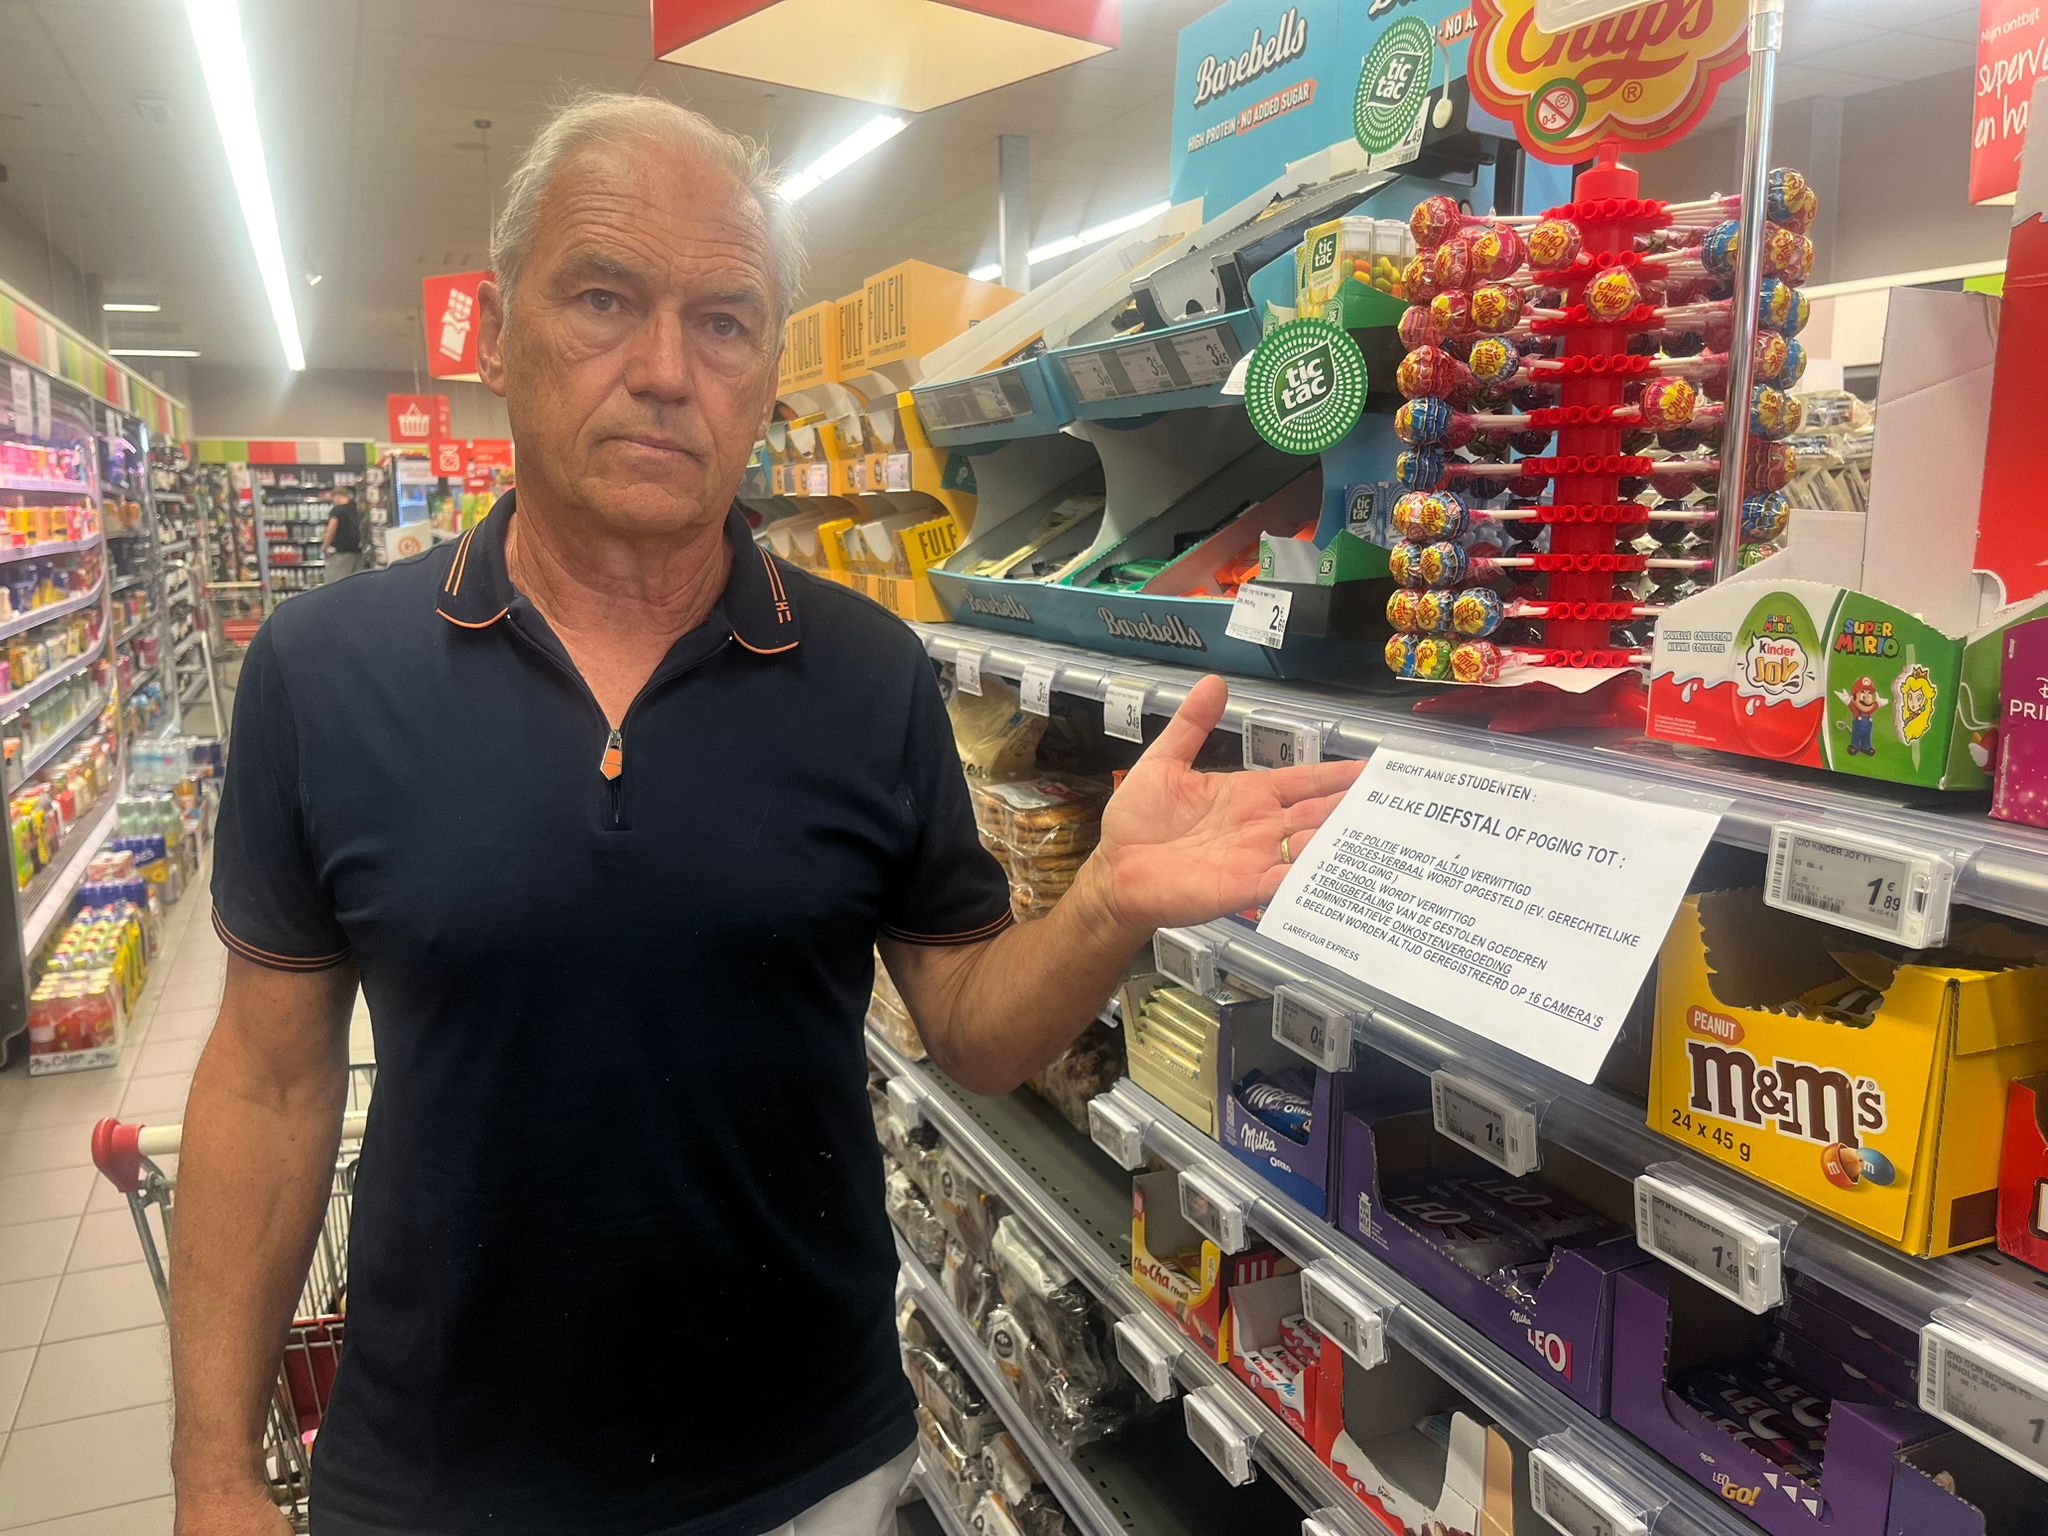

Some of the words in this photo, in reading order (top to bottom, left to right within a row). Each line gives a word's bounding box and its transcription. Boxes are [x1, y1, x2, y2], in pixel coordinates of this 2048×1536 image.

[1445, 15, 1464, 39] NO
[1981, 25, 2000, 44] Mijn
[2003, 7, 2040, 36] ontbijt
[1193, 7, 1307, 110] Barebells
[1387, 57, 1412, 82] tic
[1375, 78, 1405, 100] tac
[1188, 131, 1205, 152] HIGH
[1206, 117, 1236, 145] PROTEIN
[1241, 110, 1252, 128] NO
[1254, 97, 1280, 122] ADDED
[1281, 83, 1310, 110] SUGAR
[1542, 114, 1557, 125] 0-5
[1975, 116, 1996, 149] en
[1319, 239, 1334, 254] tic
[1315, 253, 1332, 267] tac
[1593, 291, 1628, 309] Chups
[1599, 281, 1632, 294] Chupa
[868, 274, 906, 346] FULFIL
[1206, 344, 1220, 366] 3
[1285, 358, 1323, 388] tic
[1281, 376, 1327, 409] tac
[1667, 383, 1686, 415] Chupa
[1353, 508, 1369, 520] tac
[1357, 496, 1370, 511] tic
[918, 523, 956, 560] FULF
[968, 591, 1034, 622] Barebells
[1269, 605, 1280, 631] 2
[1767, 614, 1791, 624] SUPER
[1097, 605, 1207, 651] Barebells
[1663, 631, 1691, 640] NOUVELLE
[1694, 631, 1732, 641] COLLECTION
[1763, 622, 1794, 634] MARIO
[1844, 618, 1894, 638] SUPER
[1668, 642, 1690, 651] NIEUWE
[1692, 643, 1725, 653] COLLECTIE
[1759, 641, 1795, 657] kinder
[1834, 632, 1900, 658] MARIO
[1753, 657, 1799, 685] JOY
[1126, 704, 1132, 726] 3
[1280, 743, 1288, 761] 0
[1385, 760, 1424, 777] BERICHT
[1424, 768, 1444, 781] AAN
[1444, 772, 1457, 784] DE
[1458, 773, 1532, 801] STUDENTEN
[1367, 790, 1388, 805] BIJ
[1388, 796, 1425, 815] ELKE
[1424, 802, 1501, 837] DIEFSTAL
[1505, 825, 1526, 842] OF
[1526, 831, 1584, 858] POGING
[1586, 845, 1619, 866] TOT
[1812, 842, 1842, 856] KINDER
[1844, 849, 1862, 860] JOY
[1333, 852, 1394, 880] VERVOLGING
[1361, 834, 1400, 854] POLITIE
[1400, 845, 1437, 866] WORDT
[1434, 858, 1469, 879] ALTIJD
[1472, 868, 1532, 897] VERWITTIGD
[1337, 868, 1376, 892] SCHOOL
[1379, 884, 1417, 904] WORDT
[1416, 898, 1476, 927] VERWITTIGD
[1867, 877, 1883, 905] 1
[1887, 882, 1896, 891] €
[1426, 870, 1464, 890] WORDT
[1463, 883, 1524, 911] OPGESTELD
[1524, 903, 1545, 918] (EV.
[1547, 910, 1640, 948] GERECHTELIJKE
[1884, 895, 1901, 911] 89
[1283, 922, 1326, 946] CARREFOUR
[1325, 942, 1360, 961] EXPRESS
[1390, 920, 1513, 977] ONKOSTENVERGOEDING
[1396, 907, 1416, 921] VAN
[1418, 914, 1432, 927] DE
[1432, 920, 1487, 948] GESTOLEN
[1487, 941, 1548, 971] GOEDEREN
[1345, 916, 1389, 941] WORDEN
[1387, 933, 1423, 955] ALTIJD
[1423, 950, 1509, 991] GEREGISTREERD
[1510, 984, 1527, 997] OP
[1527, 992, 1542, 1005] 16
[1542, 996, 1604, 1030] CAMERA'S
[1694, 1010, 1736, 1041] PEANUT
[1241, 1122, 1277, 1152] Milka
[1485, 1123, 1494, 1142] 1
[1671, 1109, 1692, 1131] 24
[1698, 1121, 1706, 1138] x
[1712, 1127, 1733, 1150] 45
[1740, 1143, 1751, 1162] g
[1827, 1161, 1840, 1175] m
[1863, 1161, 1875, 1175] m
[1387, 1196, 1471, 1224] LEO
[1712, 1245, 1723, 1268] 1
[1510, 1309, 1531, 1325] Milka
[1528, 1328, 1566, 1372] LEO
[2029, 1418, 2045, 1444] 1
[1712, 1472, 1730, 1485] LEO
[1722, 1483, 1761, 1507] GO!
